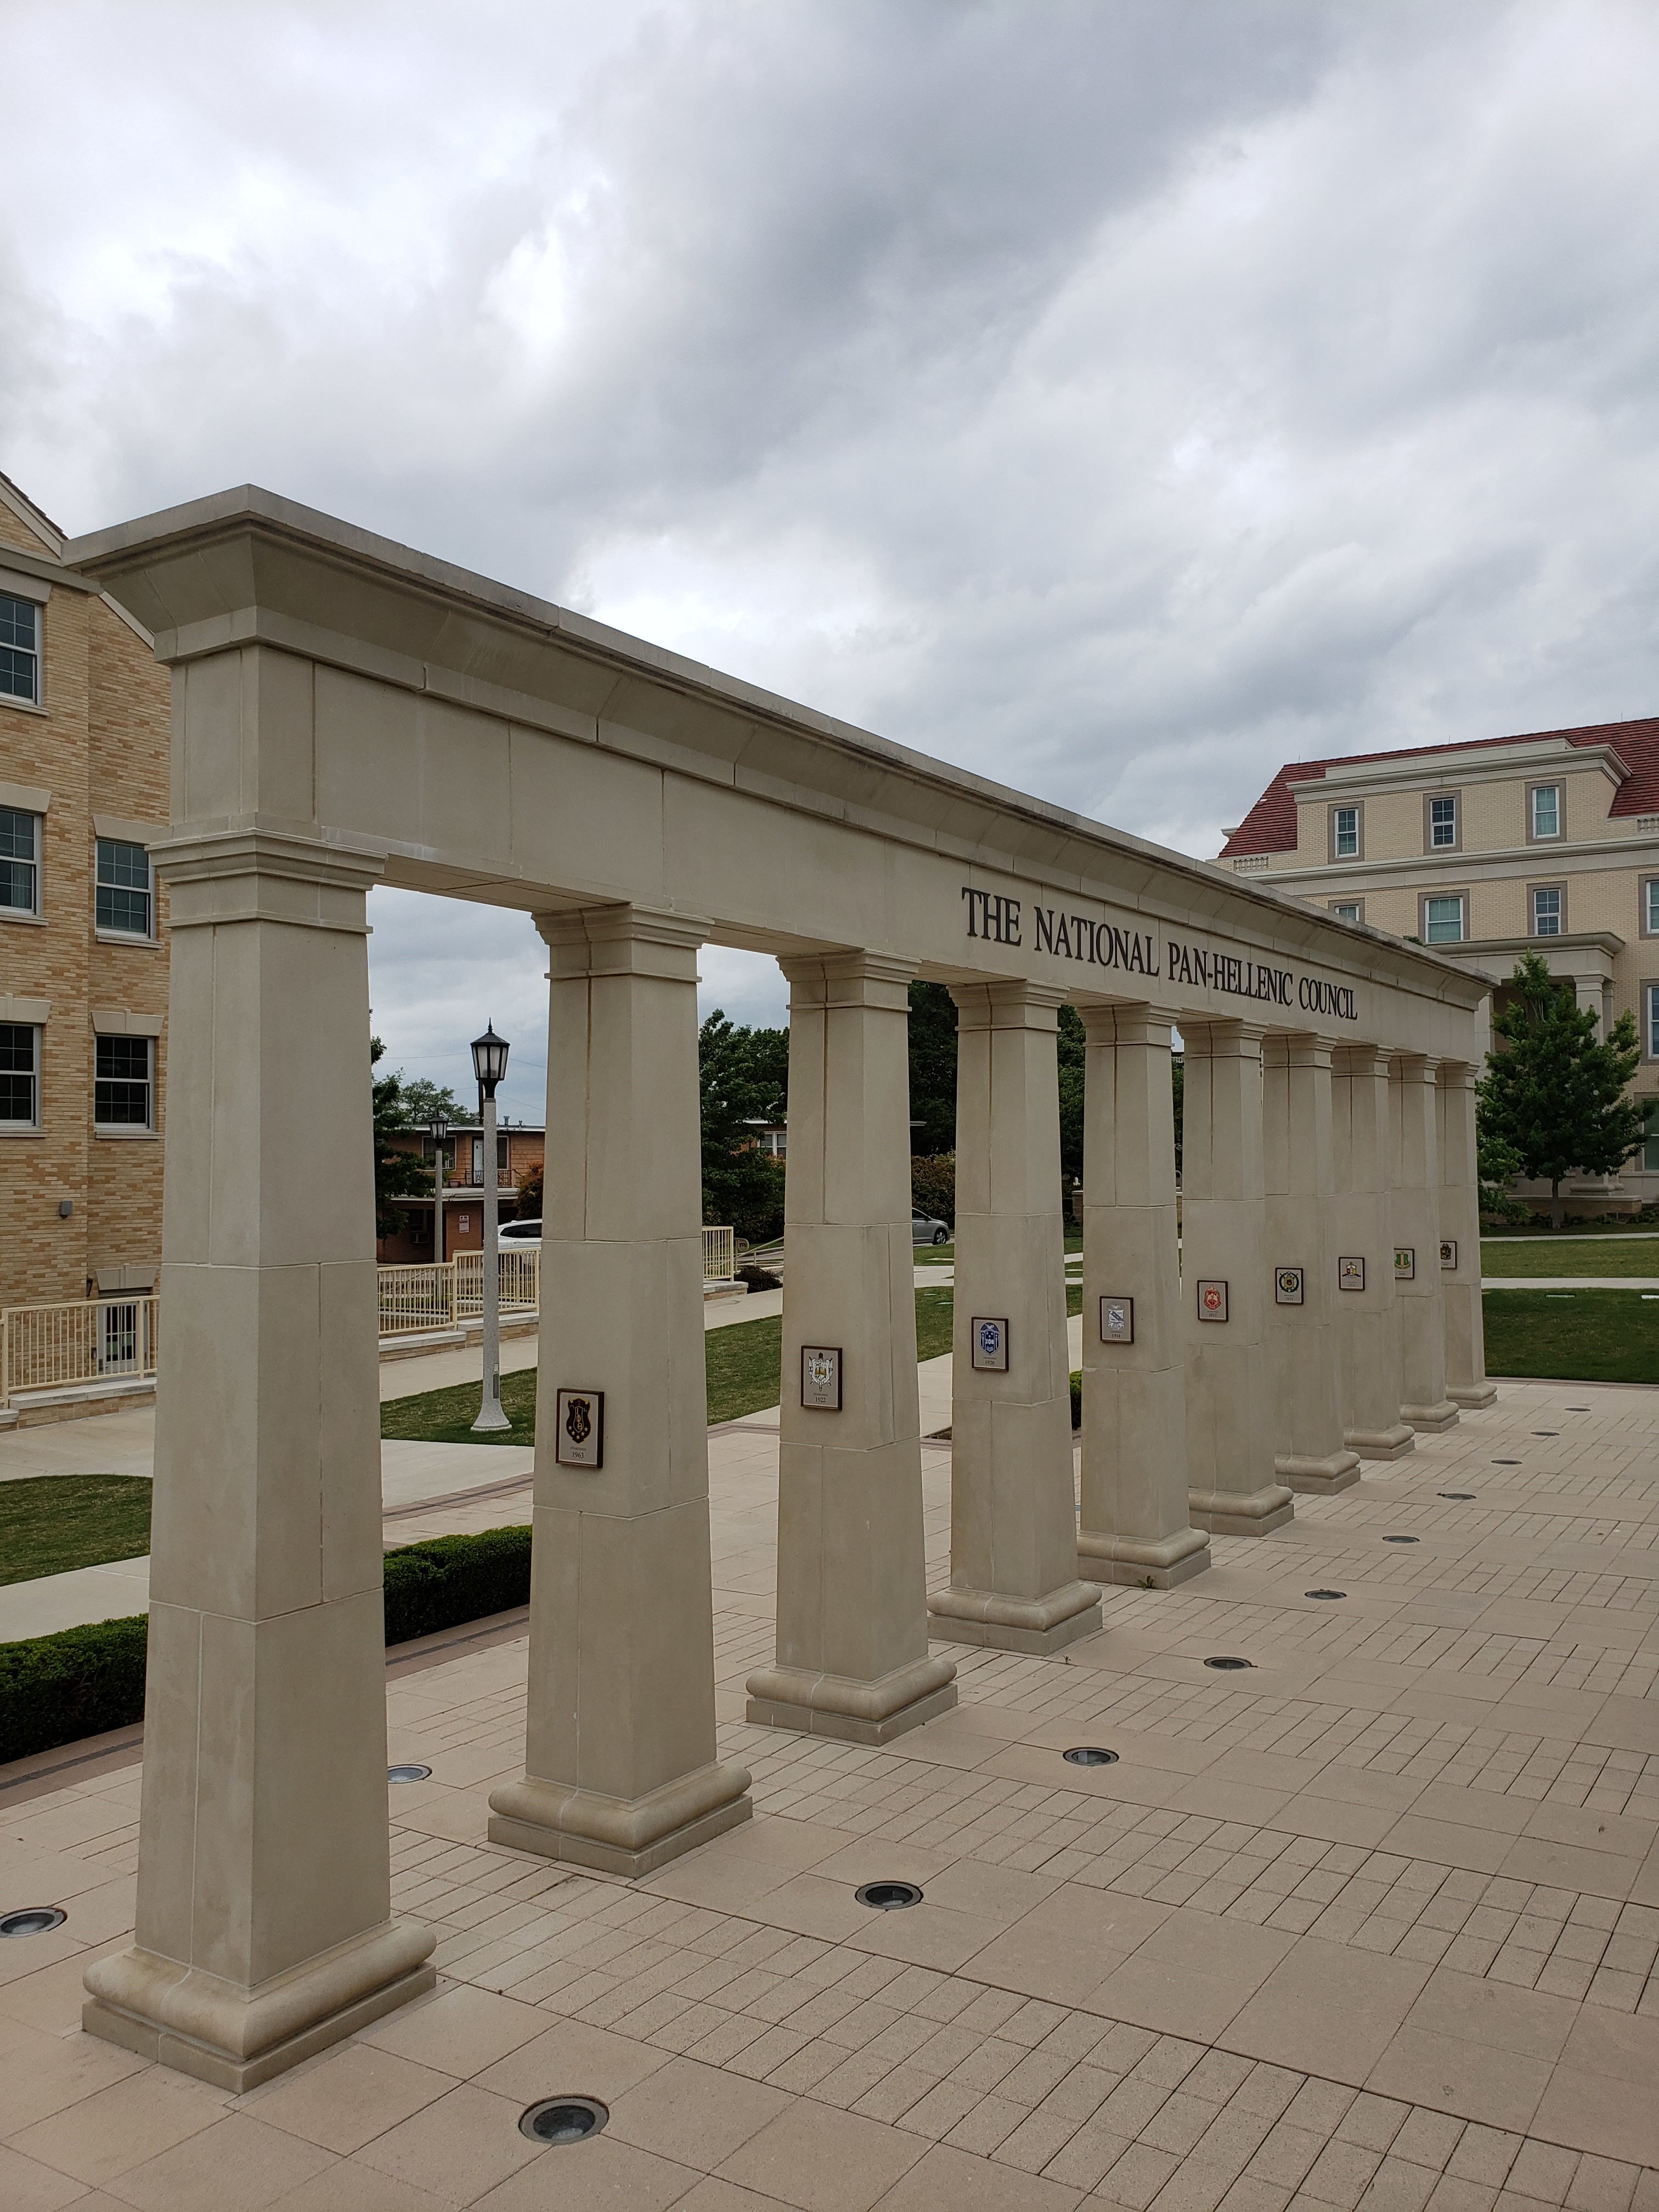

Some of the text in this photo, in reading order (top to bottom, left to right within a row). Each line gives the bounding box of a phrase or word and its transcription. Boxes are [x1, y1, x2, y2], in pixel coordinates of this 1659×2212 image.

[961, 887, 1358, 1020] THE NATIONAL PAN-HELLENIC COUNCIL
